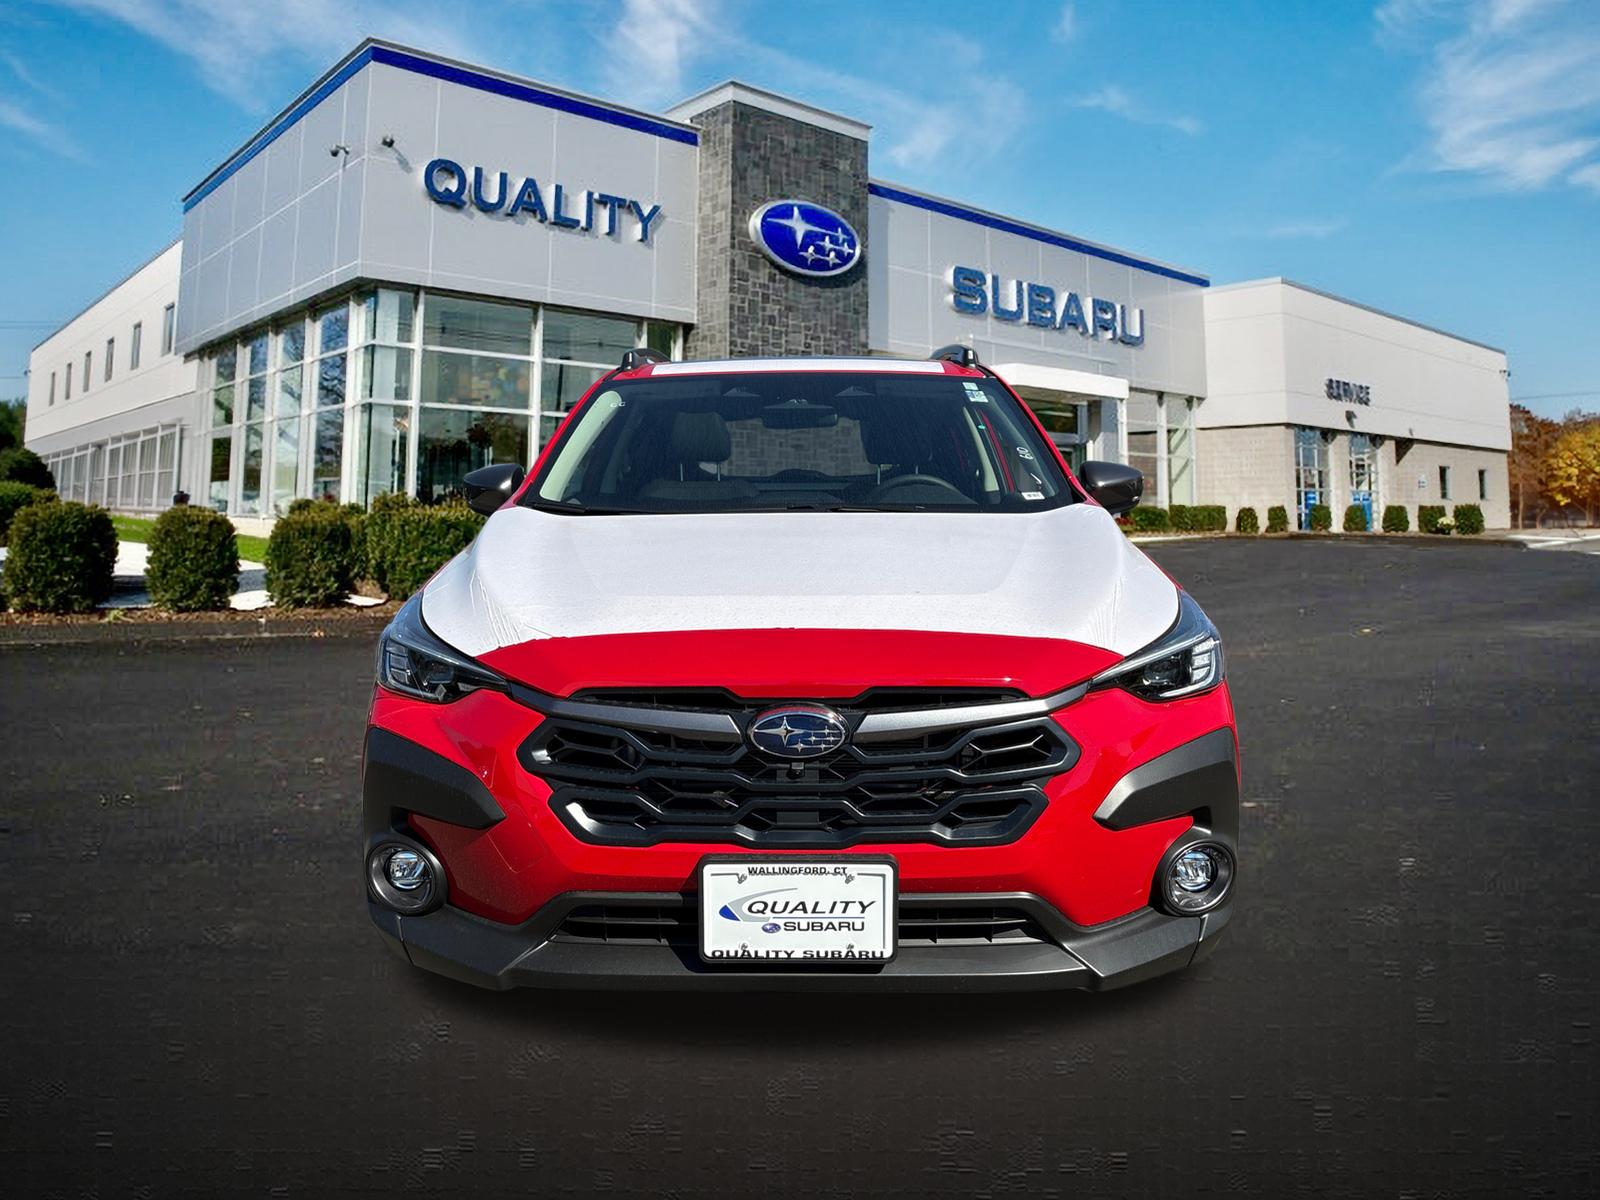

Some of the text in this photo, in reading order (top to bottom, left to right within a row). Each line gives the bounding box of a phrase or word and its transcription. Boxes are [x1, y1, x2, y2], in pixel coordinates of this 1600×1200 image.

[424, 158, 662, 243] QUALITY
[950, 265, 1145, 346] SUBARU
[833, 866, 848, 875] CT
[747, 900, 877, 914] QUALITY
[783, 921, 865, 932] SUBARU
[711, 949, 884, 960] QUALITY SUBARU
